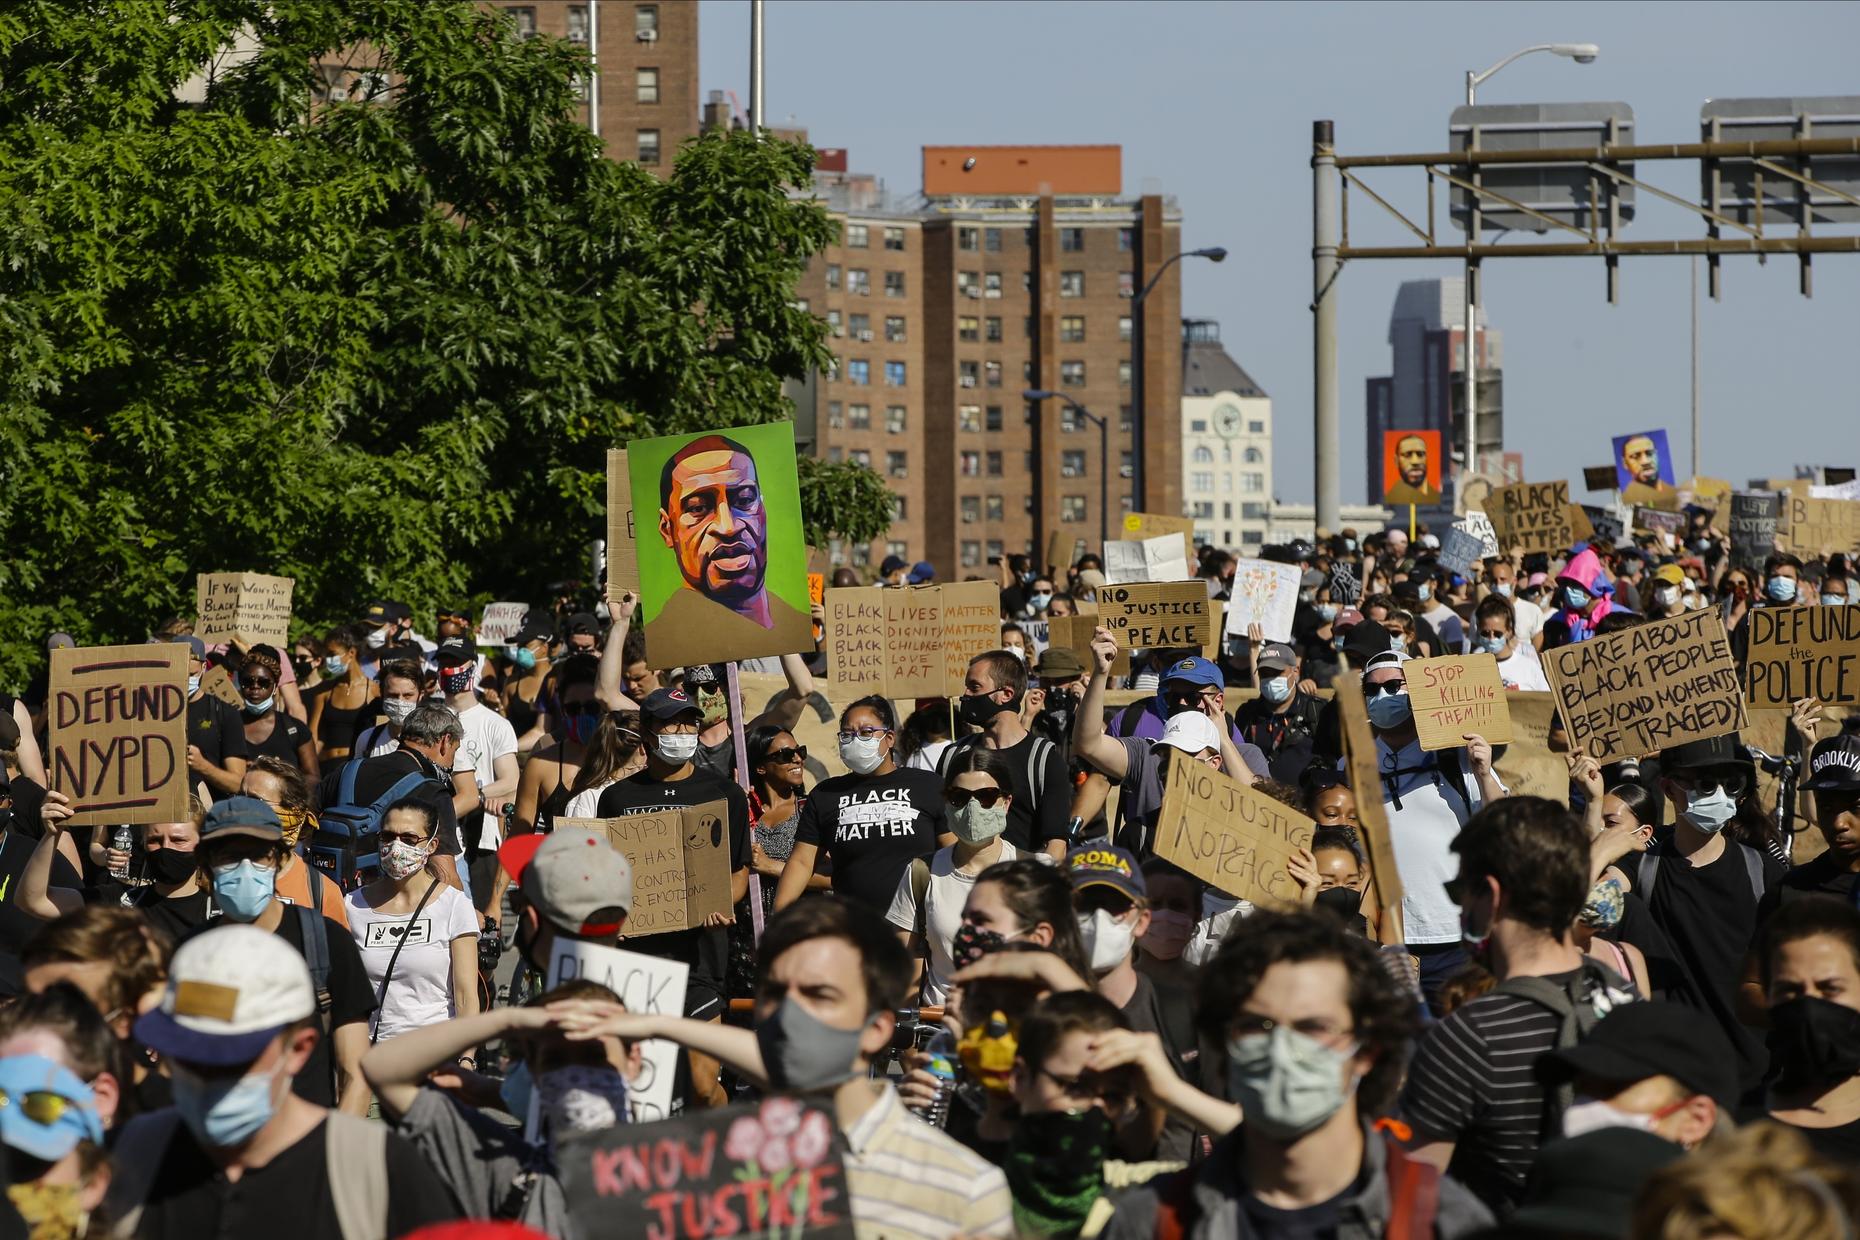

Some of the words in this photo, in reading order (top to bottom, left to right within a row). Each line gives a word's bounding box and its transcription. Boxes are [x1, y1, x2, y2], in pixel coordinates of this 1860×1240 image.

[1503, 482, 1569, 514] BLACK
[207, 579, 219, 596] IF
[223, 583, 238, 594] YOU
[1102, 588, 1129, 603] NO
[204, 598, 234, 612] BLACK
[235, 594, 263, 611] LIVES
[835, 603, 882, 621] BLACK
[888, 607, 938, 622] LIVES
[945, 605, 994, 618] MATTER
[1123, 602, 1202, 615] JUSTICE
[835, 623, 882, 636] BLACK
[888, 626, 944, 638] DIGNITY
[944, 624, 997, 635] MATTERS
[1106, 617, 1128, 630] NO
[1753, 605, 1860, 646] DEFUND
[1128, 625, 1197, 645] PEACE
[1559, 634, 1627, 677] CARE
[1632, 612, 1708, 656] ABOUT
[835, 640, 881, 655] BLACK
[888, 640, 944, 651] CHILDREN
[945, 639, 994, 650] MATTER
[1789, 647, 1814, 660] the
[838, 654, 882, 668] BLACK
[891, 653, 929, 665] LOVE
[945, 653, 972, 664] MATT
[838, 671, 881, 683] BLACK
[893, 665, 934, 680] ART
[1424, 665, 1464, 688] STOP
[1562, 662, 1643, 709] BLACK
[1644, 639, 1730, 682] PEOPLE
[1749, 655, 1857, 704] POLICE
[1440, 685, 1494, 705] KILLING
[1571, 695, 1654, 740] BEYOND
[1656, 668, 1737, 709] MOMENTS
[56, 684, 185, 729] DEFUND
[1431, 703, 1492, 726] THEM!!!
[1589, 730, 1623, 759] OF
[1625, 694, 1742, 748] TRAGEDY
[55, 734, 175, 798] NYPD
[838, 788, 911, 809] BLACK
[1175, 758, 1213, 800] NO
[1220, 785, 1311, 847] JUSTICE
[834, 820, 916, 842] MATTER
[313, 855, 335, 868] LiveU
[644, 848, 676, 866] HAS
[1072, 850, 1132, 873] ROMA
[1175, 816, 1216, 860] NO
[1216, 832, 1286, 900] PEACE
[636, 870, 697, 890] CONTROL
[647, 883, 707, 906] EMOTIONS
[628, 913, 655, 930] YOU
[663, 909, 686, 923] DO
[592, 1130, 718, 1197] KNOW
[643, 1164, 840, 1240] JUSTICE
